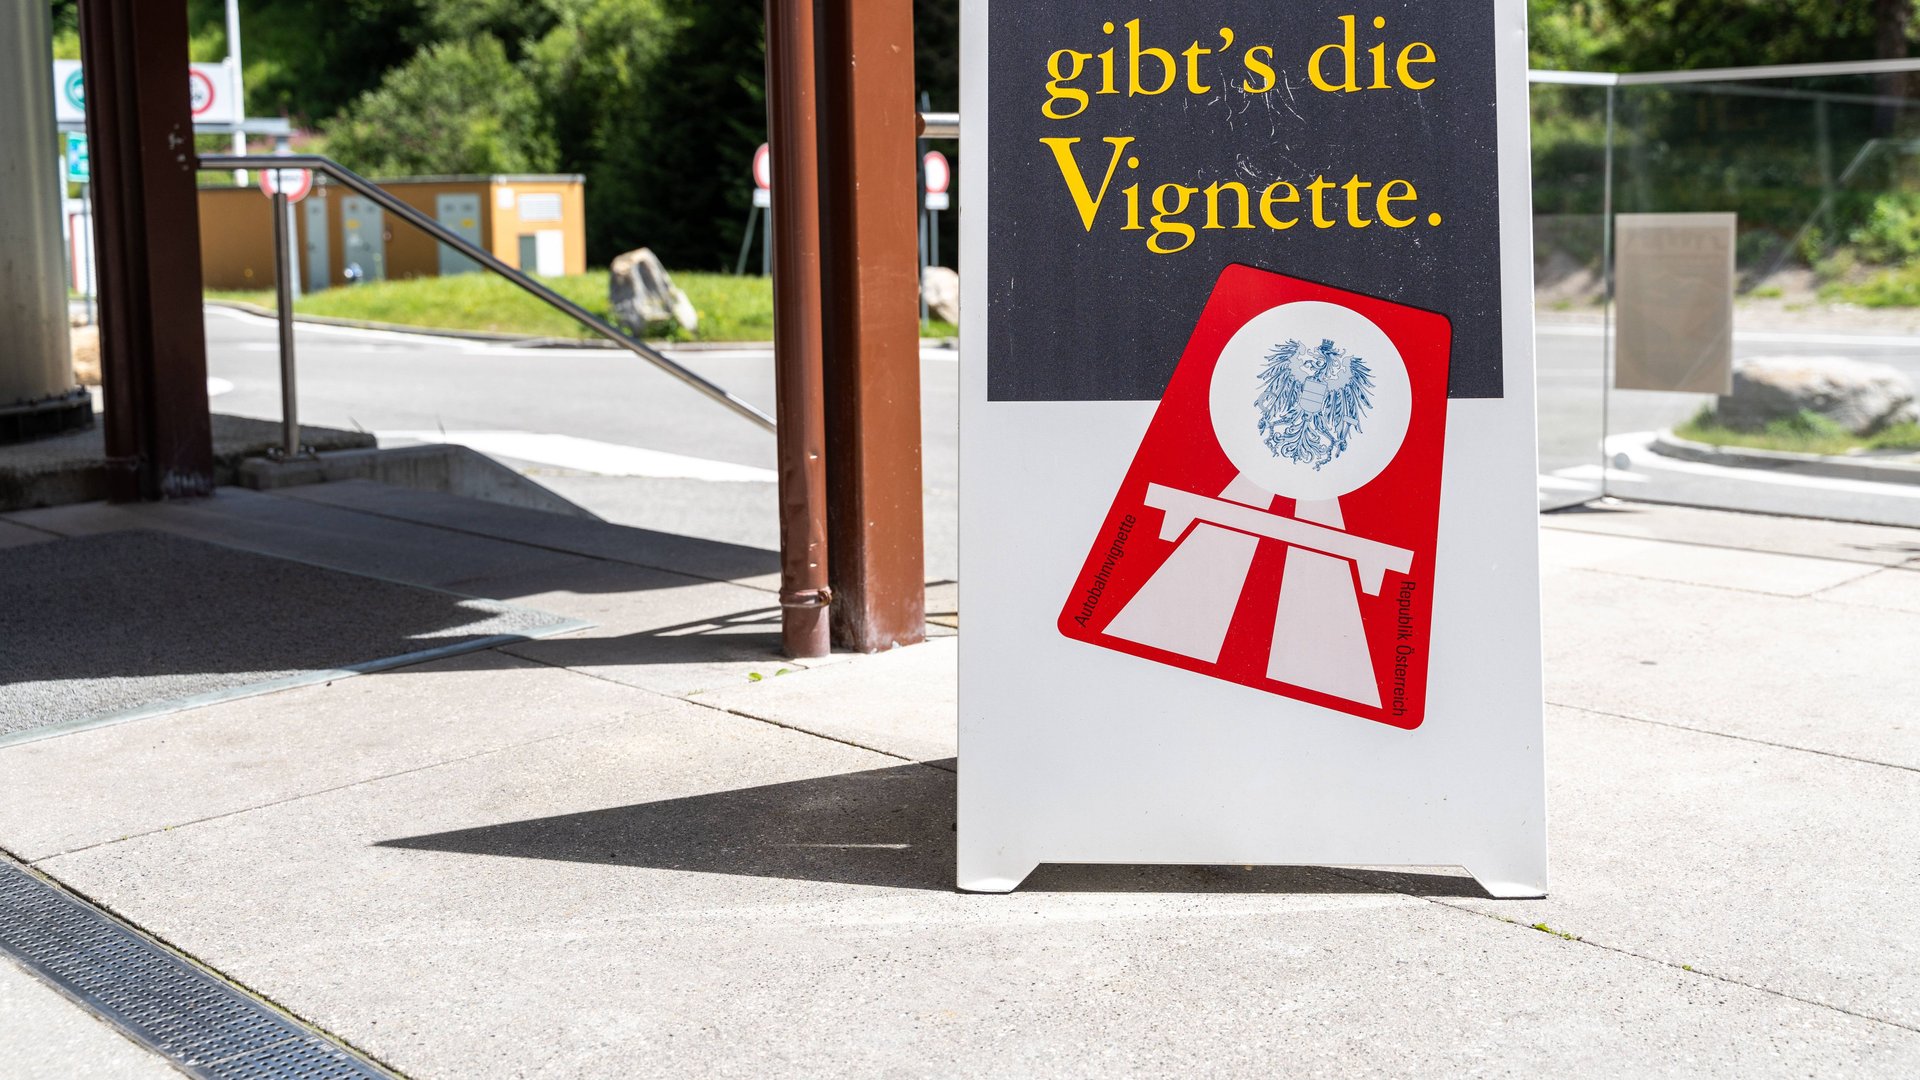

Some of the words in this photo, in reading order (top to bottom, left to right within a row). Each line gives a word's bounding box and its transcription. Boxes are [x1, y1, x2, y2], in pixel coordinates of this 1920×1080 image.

[1041, 18, 1277, 120] gibt’s
[1307, 14, 1437, 93] die
[1039, 136, 1443, 254] Vignette.
[1074, 514, 1137, 629] Autobahnvignette
[1394, 581, 1416, 641] Republik
[1392, 645, 1415, 717] Österreich
